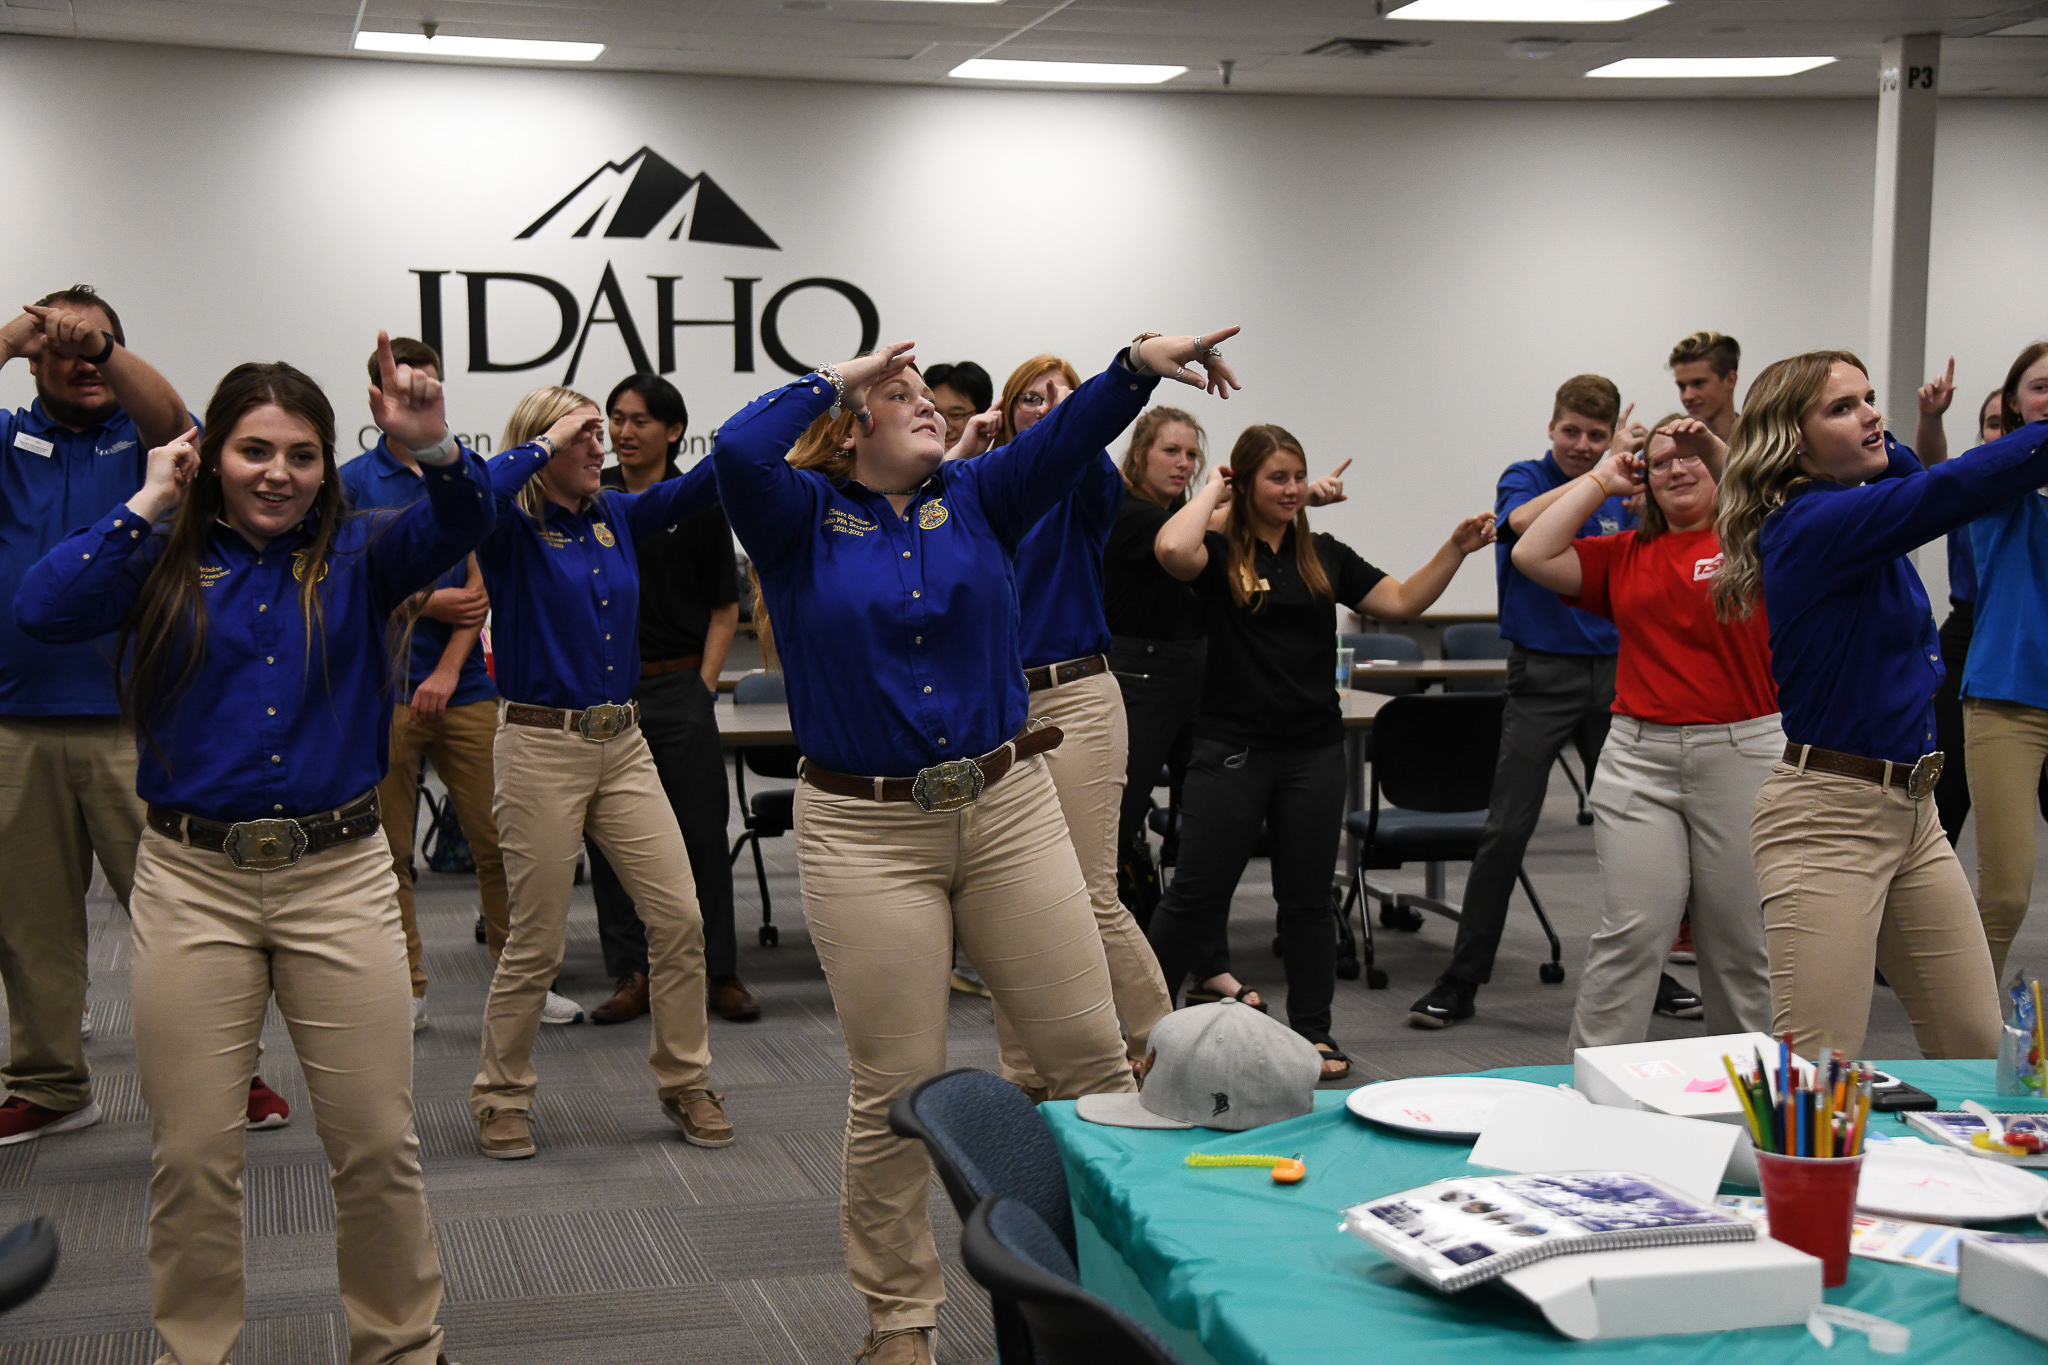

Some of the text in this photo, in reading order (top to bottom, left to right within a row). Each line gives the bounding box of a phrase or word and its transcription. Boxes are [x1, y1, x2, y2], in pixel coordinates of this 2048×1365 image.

[1908, 66, 1933, 89] P3
[408, 259, 880, 387] IDAHO
[828, 508, 871, 526] Claire Shelton
[832, 524, 864, 537] 2021-2022
[848, 521, 879, 532] Secretary
